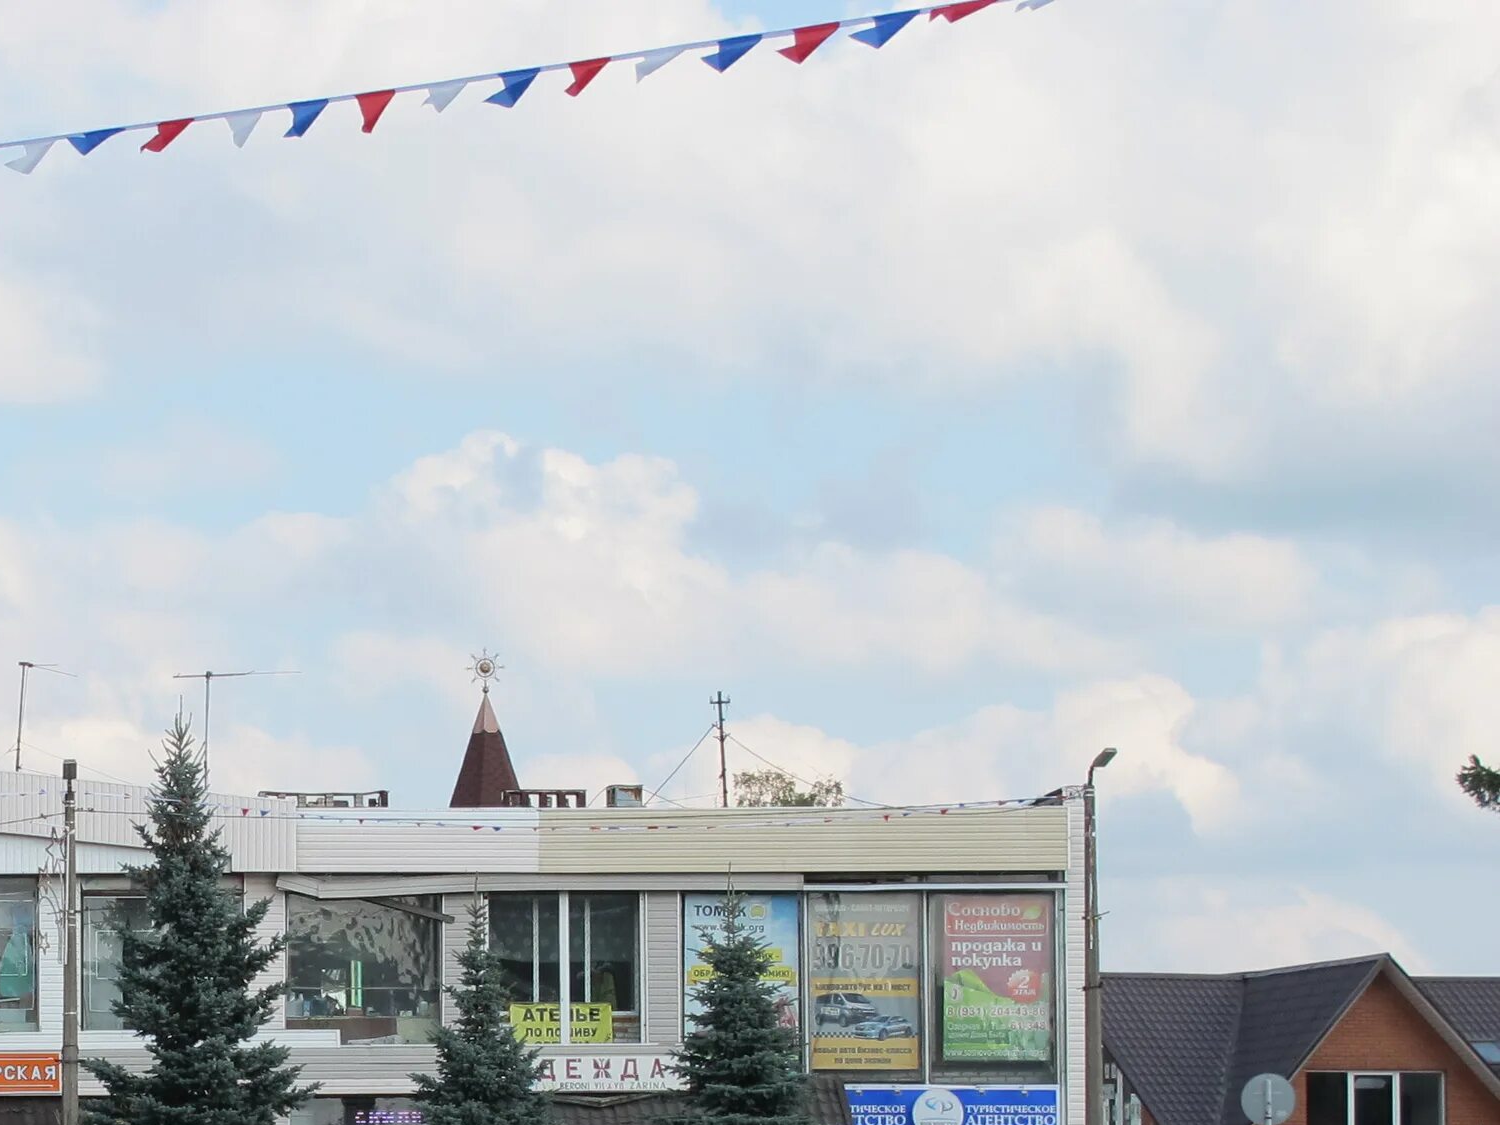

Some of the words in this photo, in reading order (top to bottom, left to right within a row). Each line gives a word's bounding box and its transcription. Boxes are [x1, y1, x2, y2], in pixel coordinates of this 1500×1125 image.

[694, 905, 747, 917] ТОМК
[947, 903, 1020, 917] Сосново
[871, 923, 906, 936] LUX
[955, 920, 1045, 933] Недвижимость
[951, 938, 1026, 954] продажа
[1031, 942, 1042, 951] и
[951, 953, 1022, 969] покупка
[1018, 975, 1031, 989] 2
[522, 1007, 601, 1022] АТЕЬЕ
[536, 1058, 667, 1081] ДЕЖДА
[850, 1104, 907, 1114] ТИЧЕСКОЕ
[965, 1104, 1057, 1114] ТУРИСТИЧЕСКОЕ
